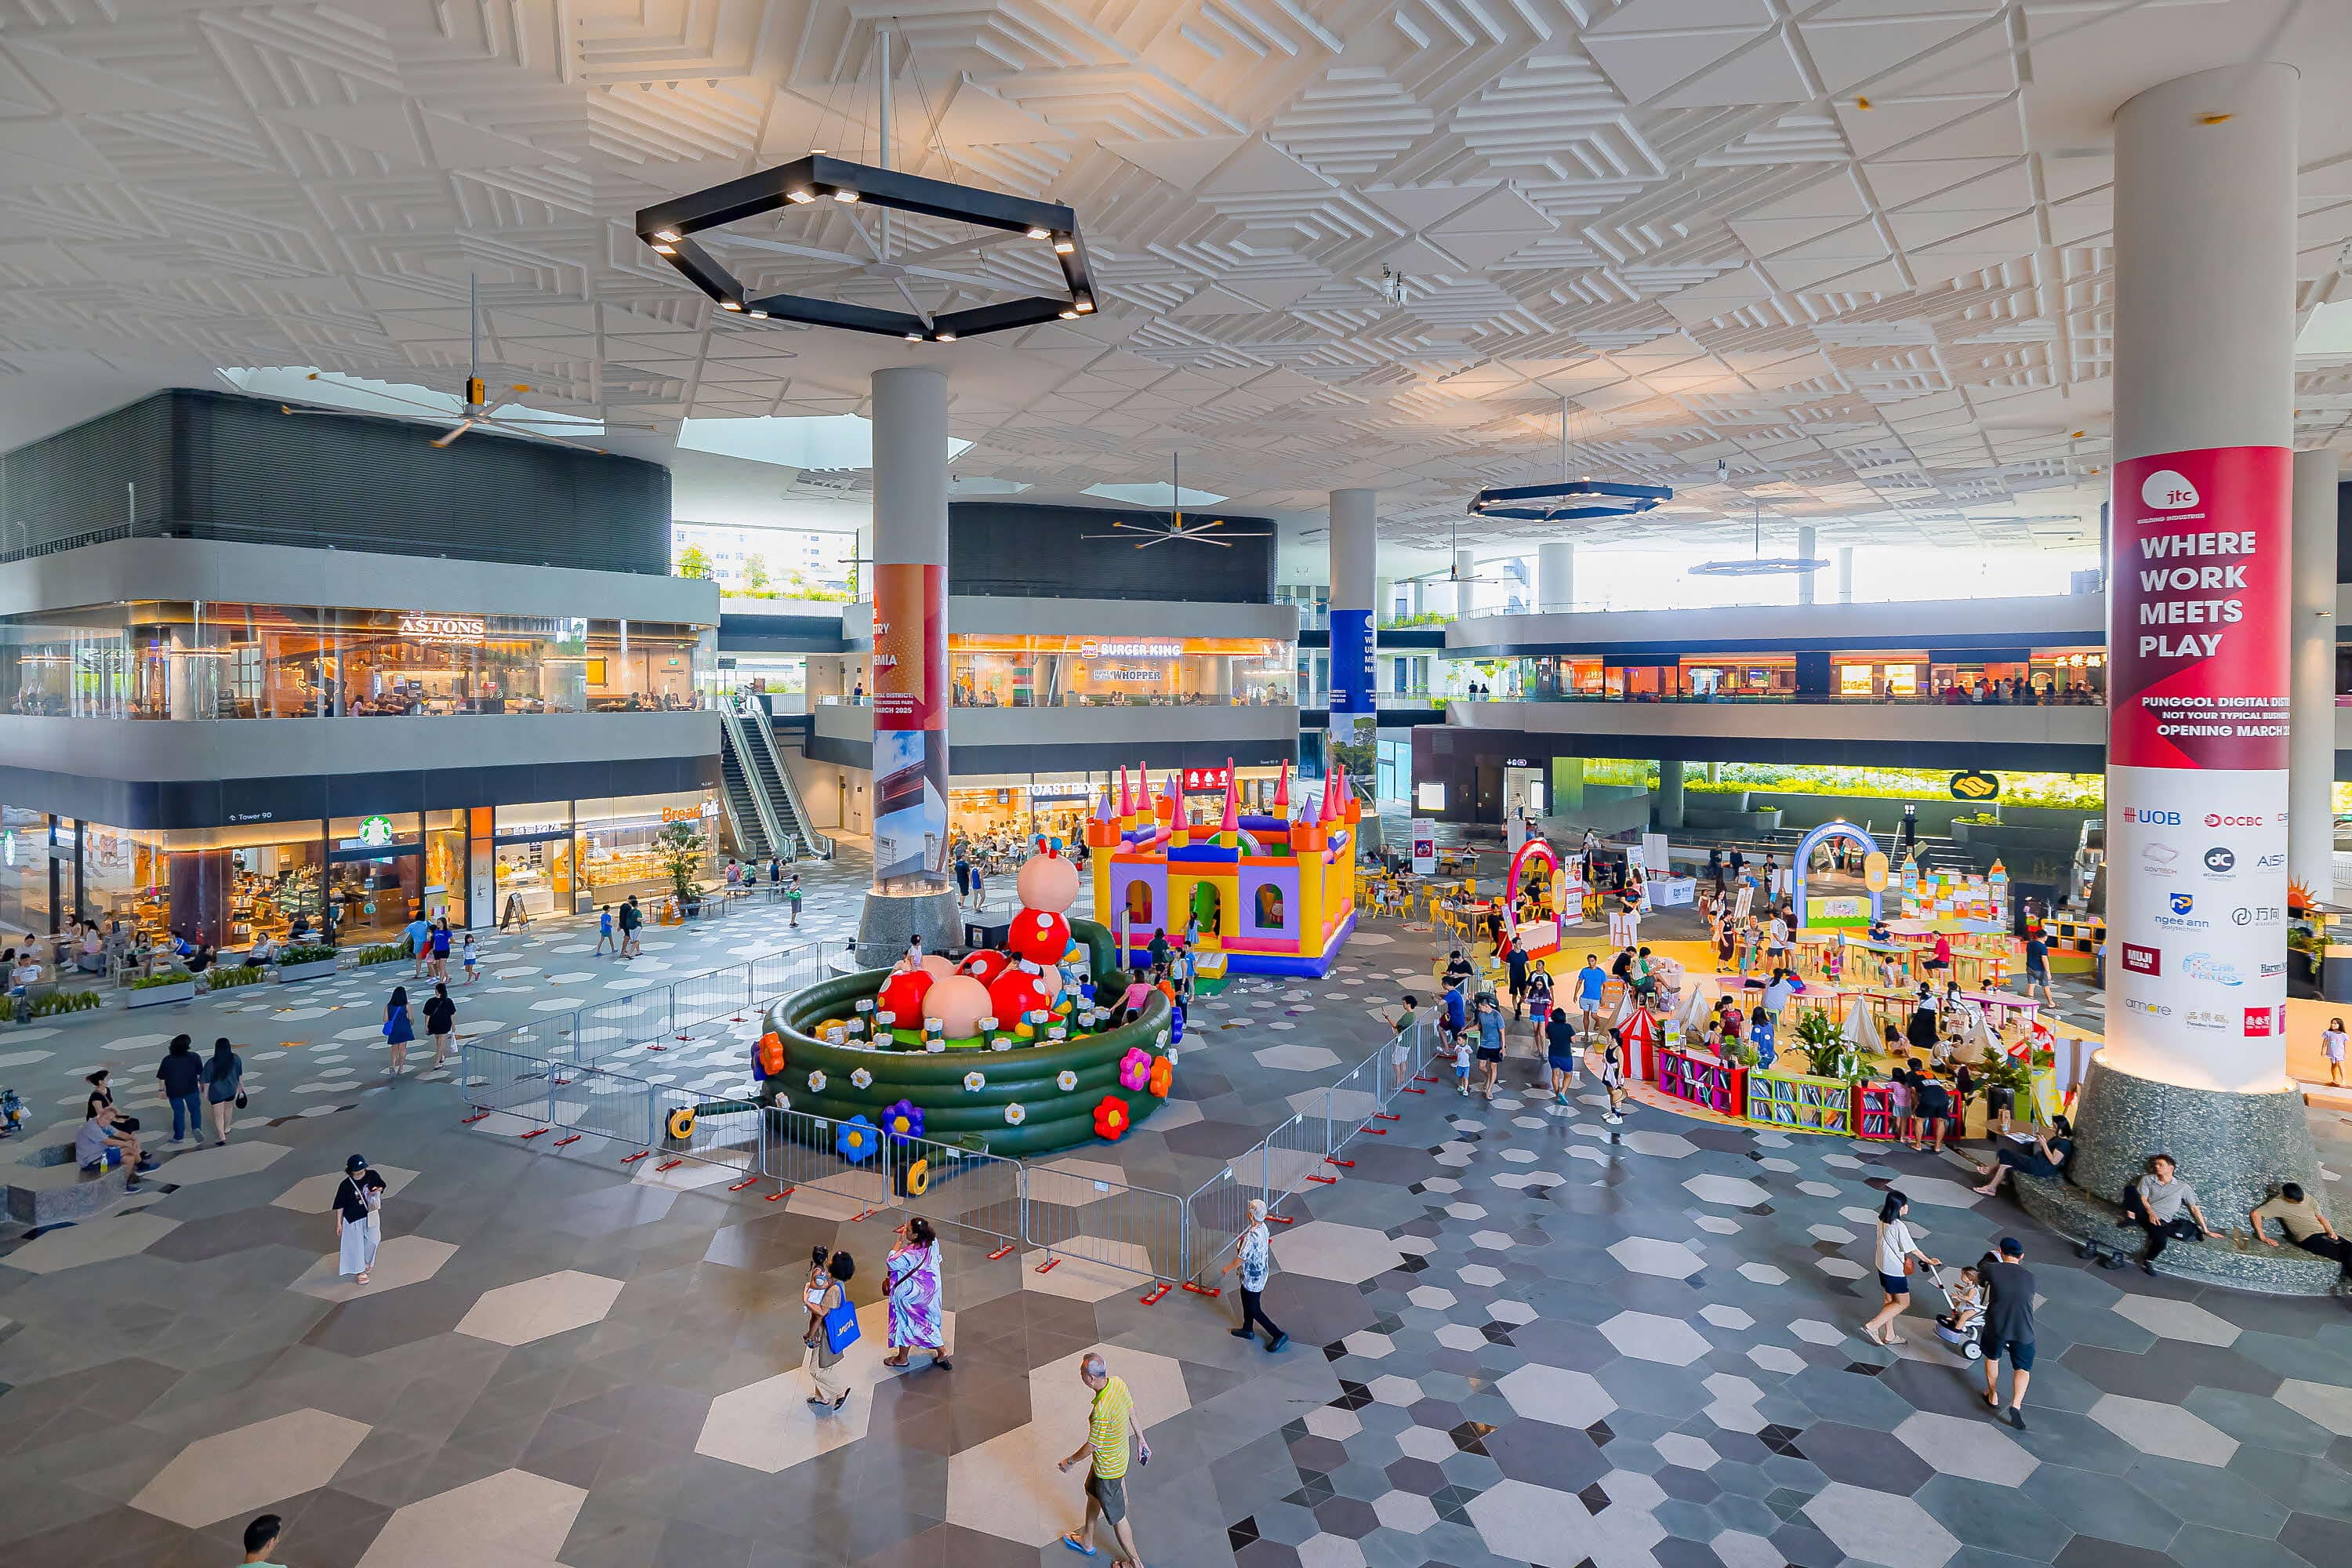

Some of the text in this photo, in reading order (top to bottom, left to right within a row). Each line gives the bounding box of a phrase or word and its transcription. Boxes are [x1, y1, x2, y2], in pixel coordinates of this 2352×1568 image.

[2167, 489, 2193, 505] jtc
[2140, 531, 2256, 559] WHERE
[2140, 565, 2248, 593] WORK
[2140, 600, 2244, 625] MEETS
[400, 619, 484, 634] ASTONS
[1101, 644, 1181, 656] BURGER KING
[2140, 633, 2223, 658] PLAY
[1112, 670, 1161, 680] WHOPPER
[2141, 696, 2215, 707] PUNGGOL
[2217, 696, 2270, 707] DIGITAL
[2162, 711, 2186, 720] NOT
[2187, 711, 2218, 720] YOUR
[2220, 711, 2261, 720] TYPICAL
[2157, 725, 2233, 736] OPENING
[2237, 725, 2283, 737] MARCH
[1025, 783, 1069, 796] TOAST
[662, 800, 720, 822] BreadTalk
[2139, 809, 2182, 826] UOB
[2223, 816, 2263, 826] OCBC
[2144, 866, 2177, 875] GOVTECH
[2155, 916, 2209, 927] ngee ann
[2161, 924, 2202, 933] polytechnic
[2127, 949, 2153, 964] MUJI
[2125, 998, 2171, 1015] amore
